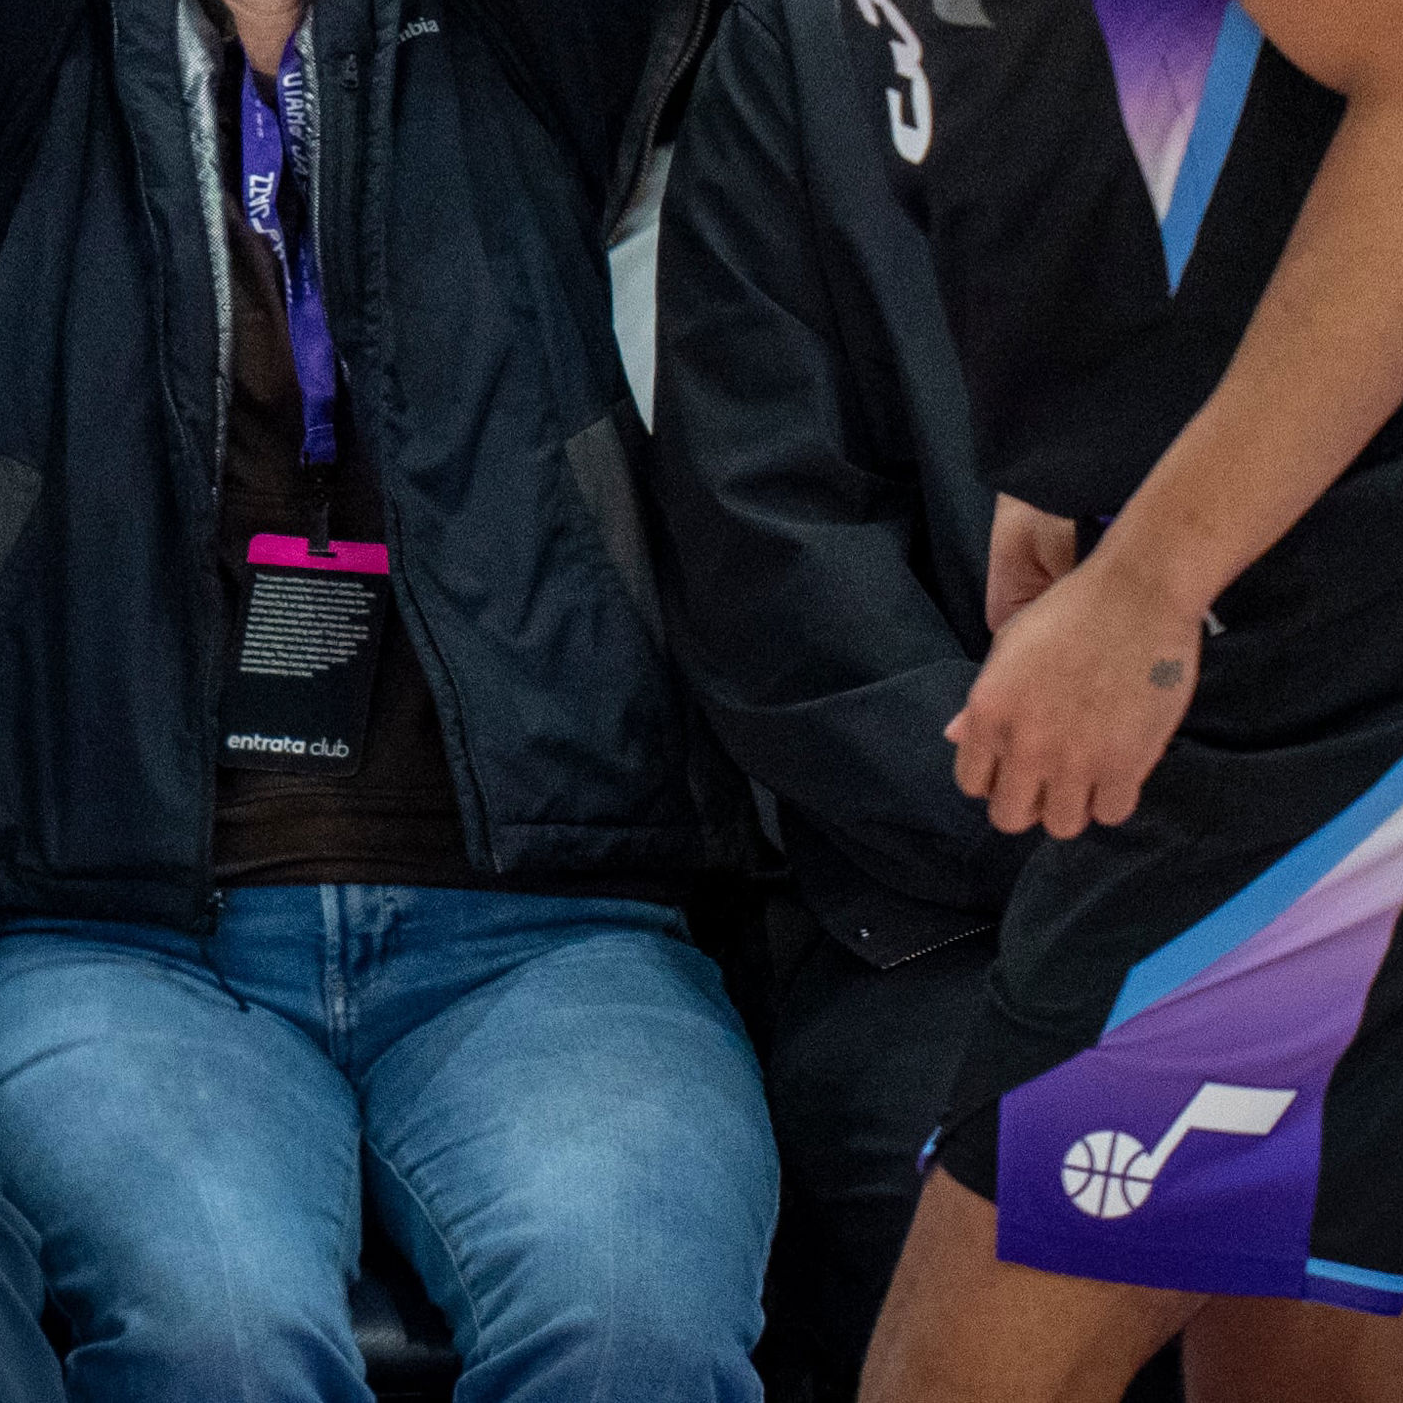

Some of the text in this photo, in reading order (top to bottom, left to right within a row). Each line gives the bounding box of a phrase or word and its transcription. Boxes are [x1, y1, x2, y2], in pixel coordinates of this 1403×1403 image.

[248, 171, 275, 219] JAZZ
[227, 733, 350, 758] entrata club
